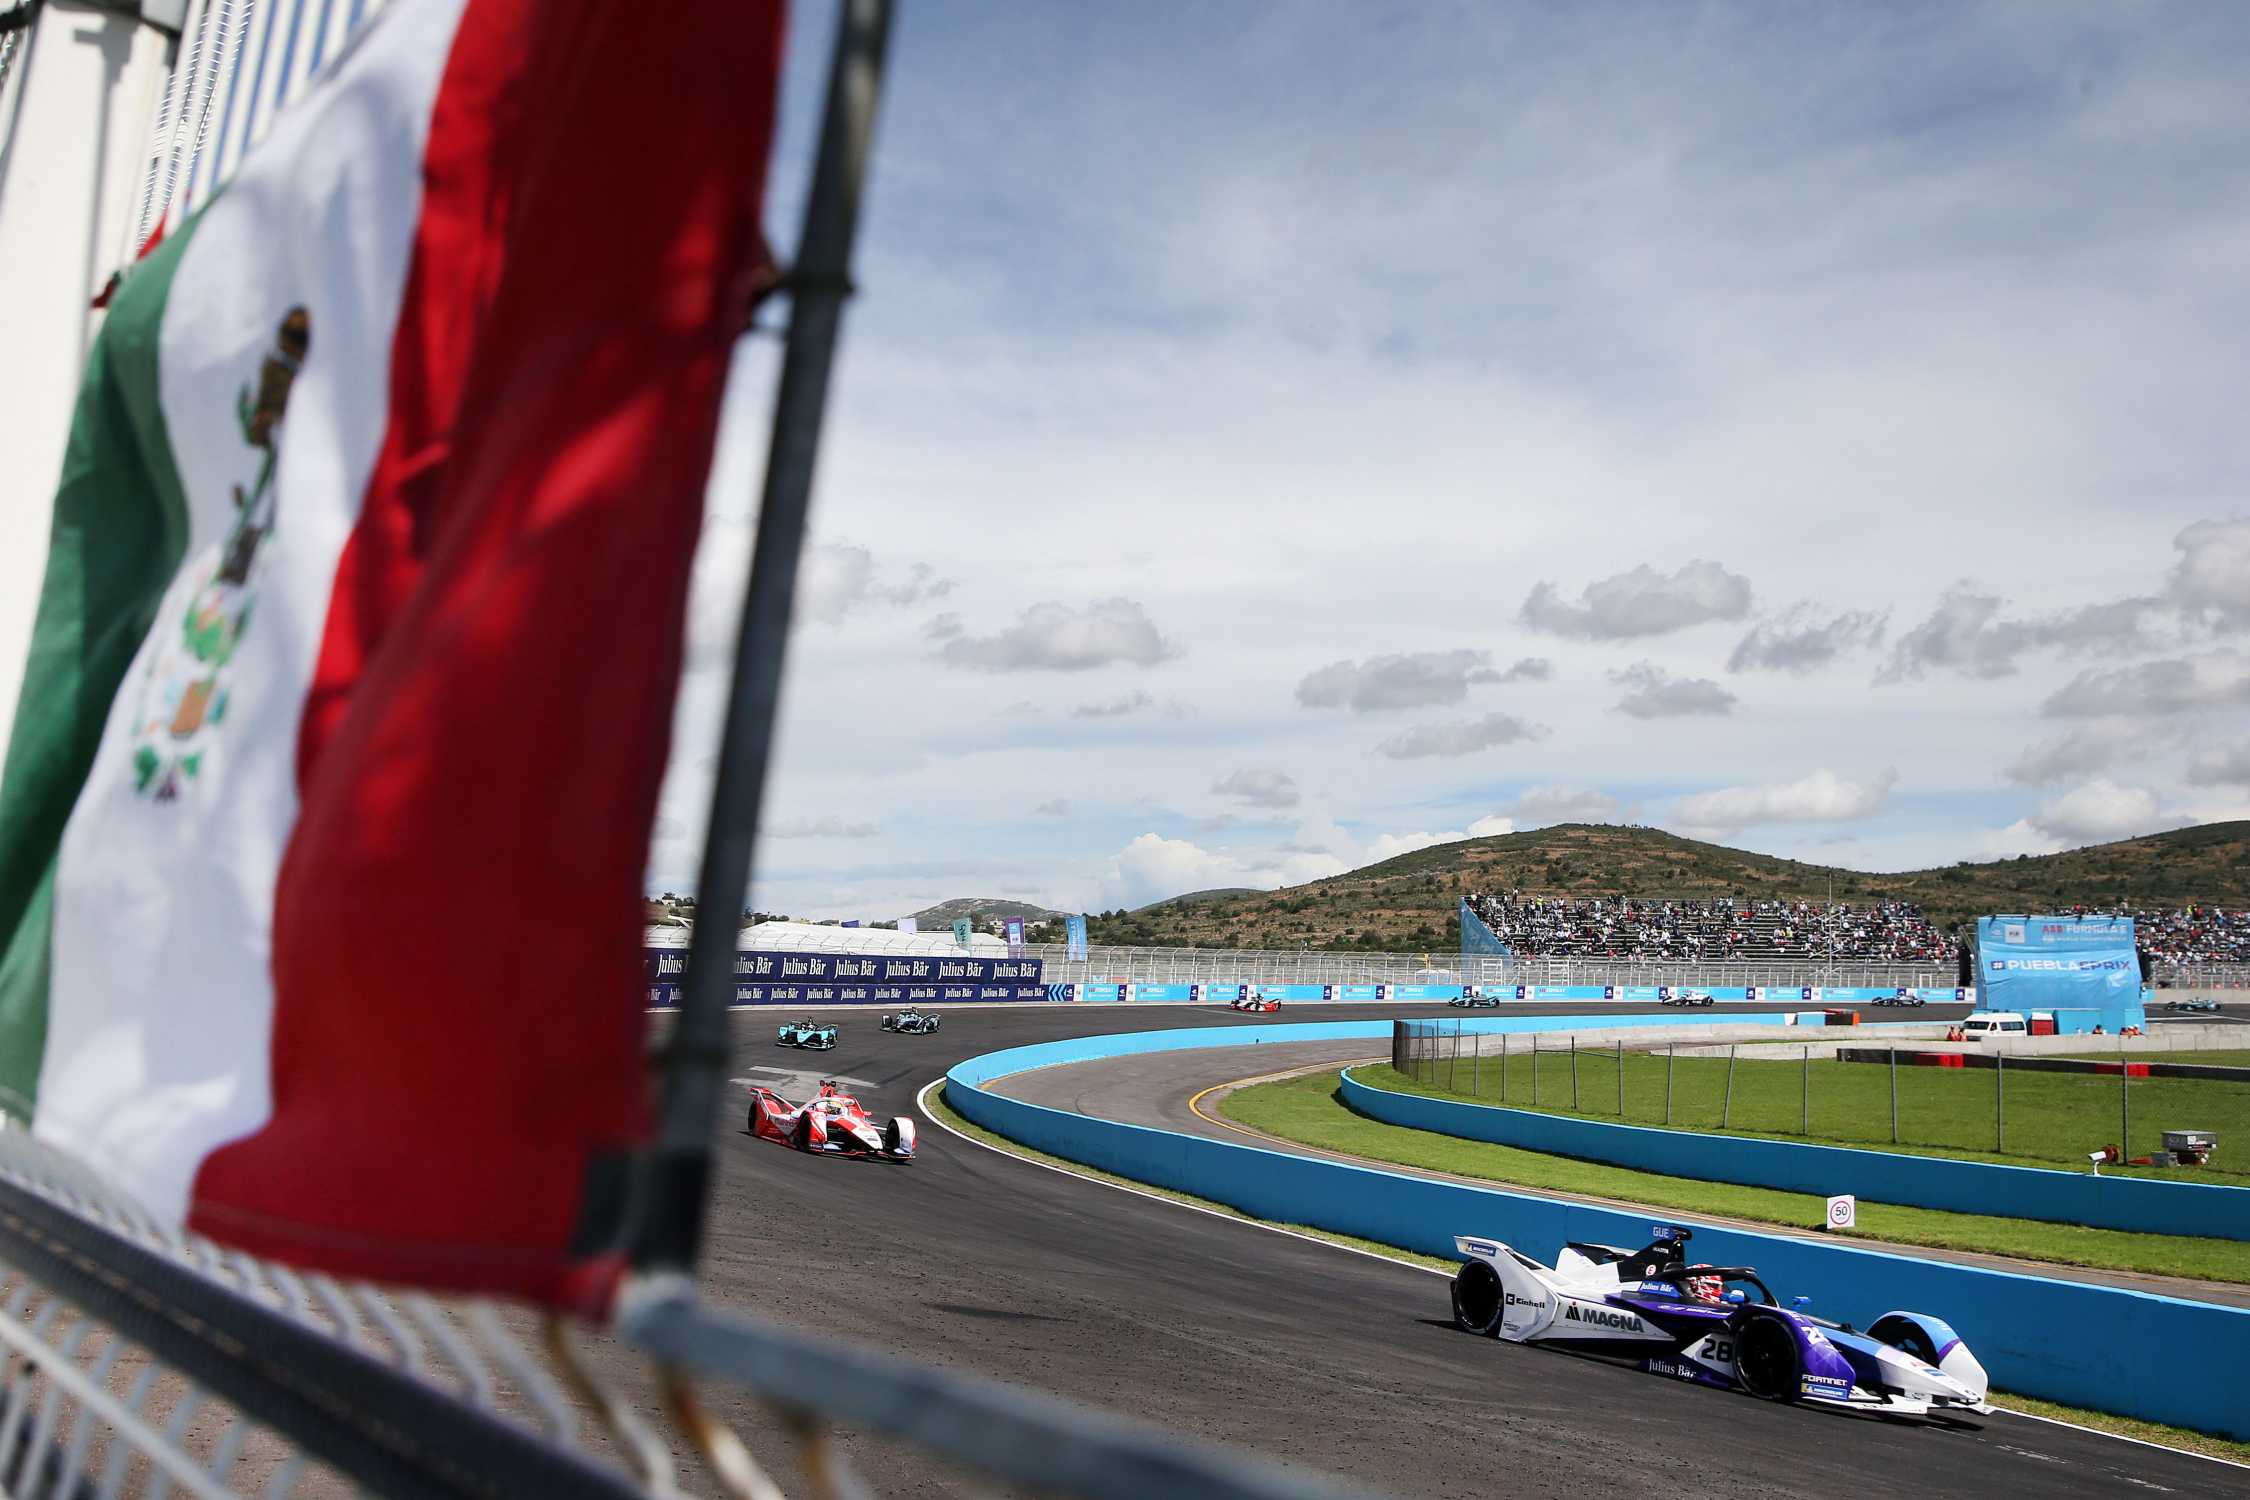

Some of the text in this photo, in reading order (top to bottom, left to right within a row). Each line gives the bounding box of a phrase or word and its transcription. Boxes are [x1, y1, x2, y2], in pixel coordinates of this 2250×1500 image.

[656, 954, 683, 977] Julius
[735, 956, 774, 975] ulius Bär
[781, 957, 827, 978] Julius Bär
[834, 959, 877, 979] Julius Bär
[884, 960, 930, 980] Julius Bär
[937, 961, 984, 980] Julius Bär
[993, 962, 1037, 980] Julius Bär
[736, 987, 763, 1001] Julius Bär
[771, 987, 798, 1000] Julius Bär
[807, 988, 834, 1000] Julius Bär
[841, 988, 866, 1000] Julius Bär
[874, 987, 901, 1000] Julius Bär
[909, 987, 937, 999] Julius Bär
[945, 987, 973, 999] Julius Bär
[981, 987, 1009, 999] Julius Bär
[1017, 986, 1045, 998] Julius Bär
[1835, 1206, 1848, 1216] 50
[1653, 1226, 1669, 1239] GUE
[1641, 1282, 1673, 1292] Julius Bär
[1516, 1297, 1545, 1309] Einhell
[1583, 1309, 1644, 1333] MAGNA
[1701, 1338, 1731, 1363] 28
[1649, 1358, 1696, 1379] Julius Bär
